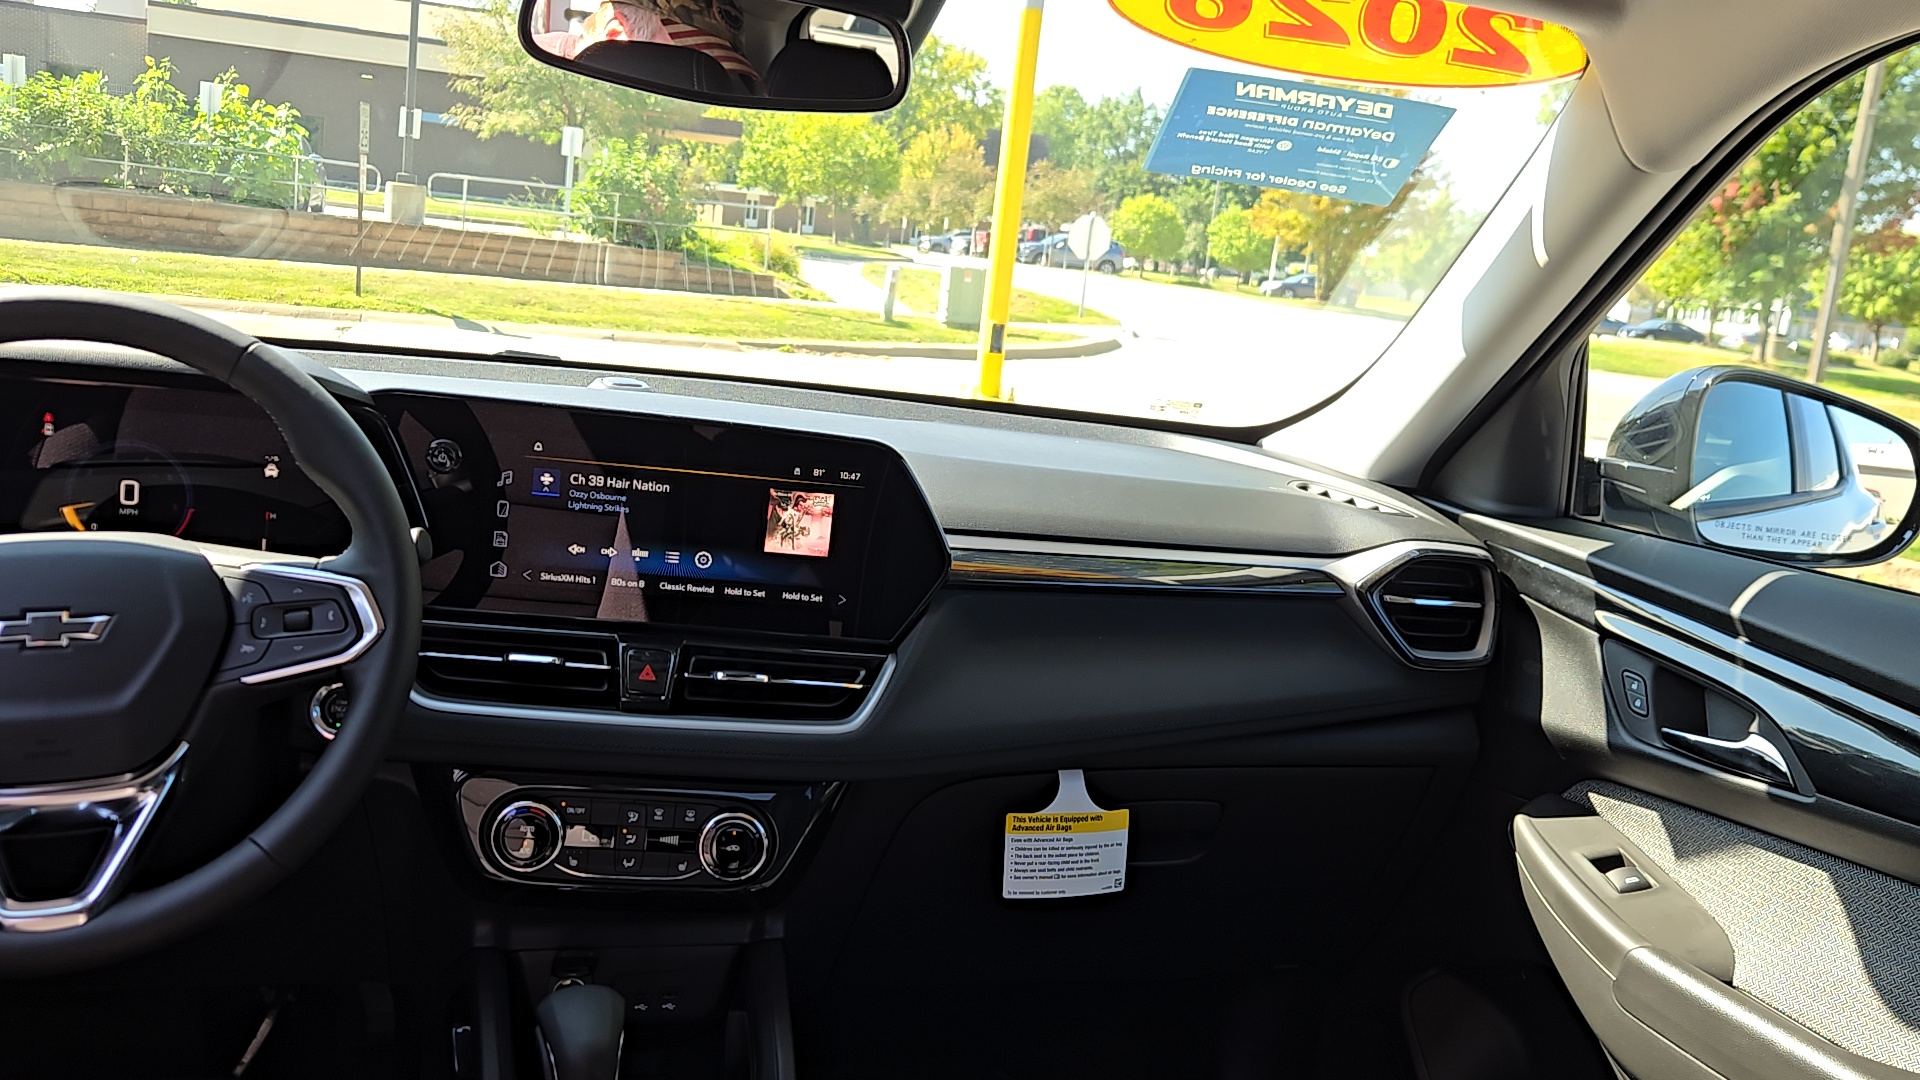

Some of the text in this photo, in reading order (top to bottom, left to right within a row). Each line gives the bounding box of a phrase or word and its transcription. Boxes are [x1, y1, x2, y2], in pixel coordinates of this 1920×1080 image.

[840, 471, 862, 480] 10:47
[569, 473, 670, 493] Ch 39 Hair Nation
[118, 479, 140, 506] 0
[568, 489, 628, 502] Ozzy Osbourne
[119, 507, 139, 516] MPH
[567, 500, 630, 514] Lightning Strikes
[1714, 520, 1752, 532] OBJECTS
[1765, 526, 1797, 537] MIRROR
[1800, 530, 1817, 539] ARE
[1741, 532, 1823, 549] THAN THEY APPEAR
[539, 571, 575, 584] SiriusXM
[575, 575, 591, 584] Hits
[610, 578, 627, 588] 80s
[626, 580, 638, 588] on
[659, 581, 715, 594] Classic Rewind
[724, 587, 766, 598] Hold to Set
[782, 591, 823, 603] Hold to Set
[1013, 815, 1027, 824] This
[1028, 815, 1051, 824] Vehicle
[1060, 815, 1089, 824] Equipped
[1090, 814, 1103, 822] with
[1012, 824, 1044, 832] Advanced
[1056, 824, 1072, 833] Bags
